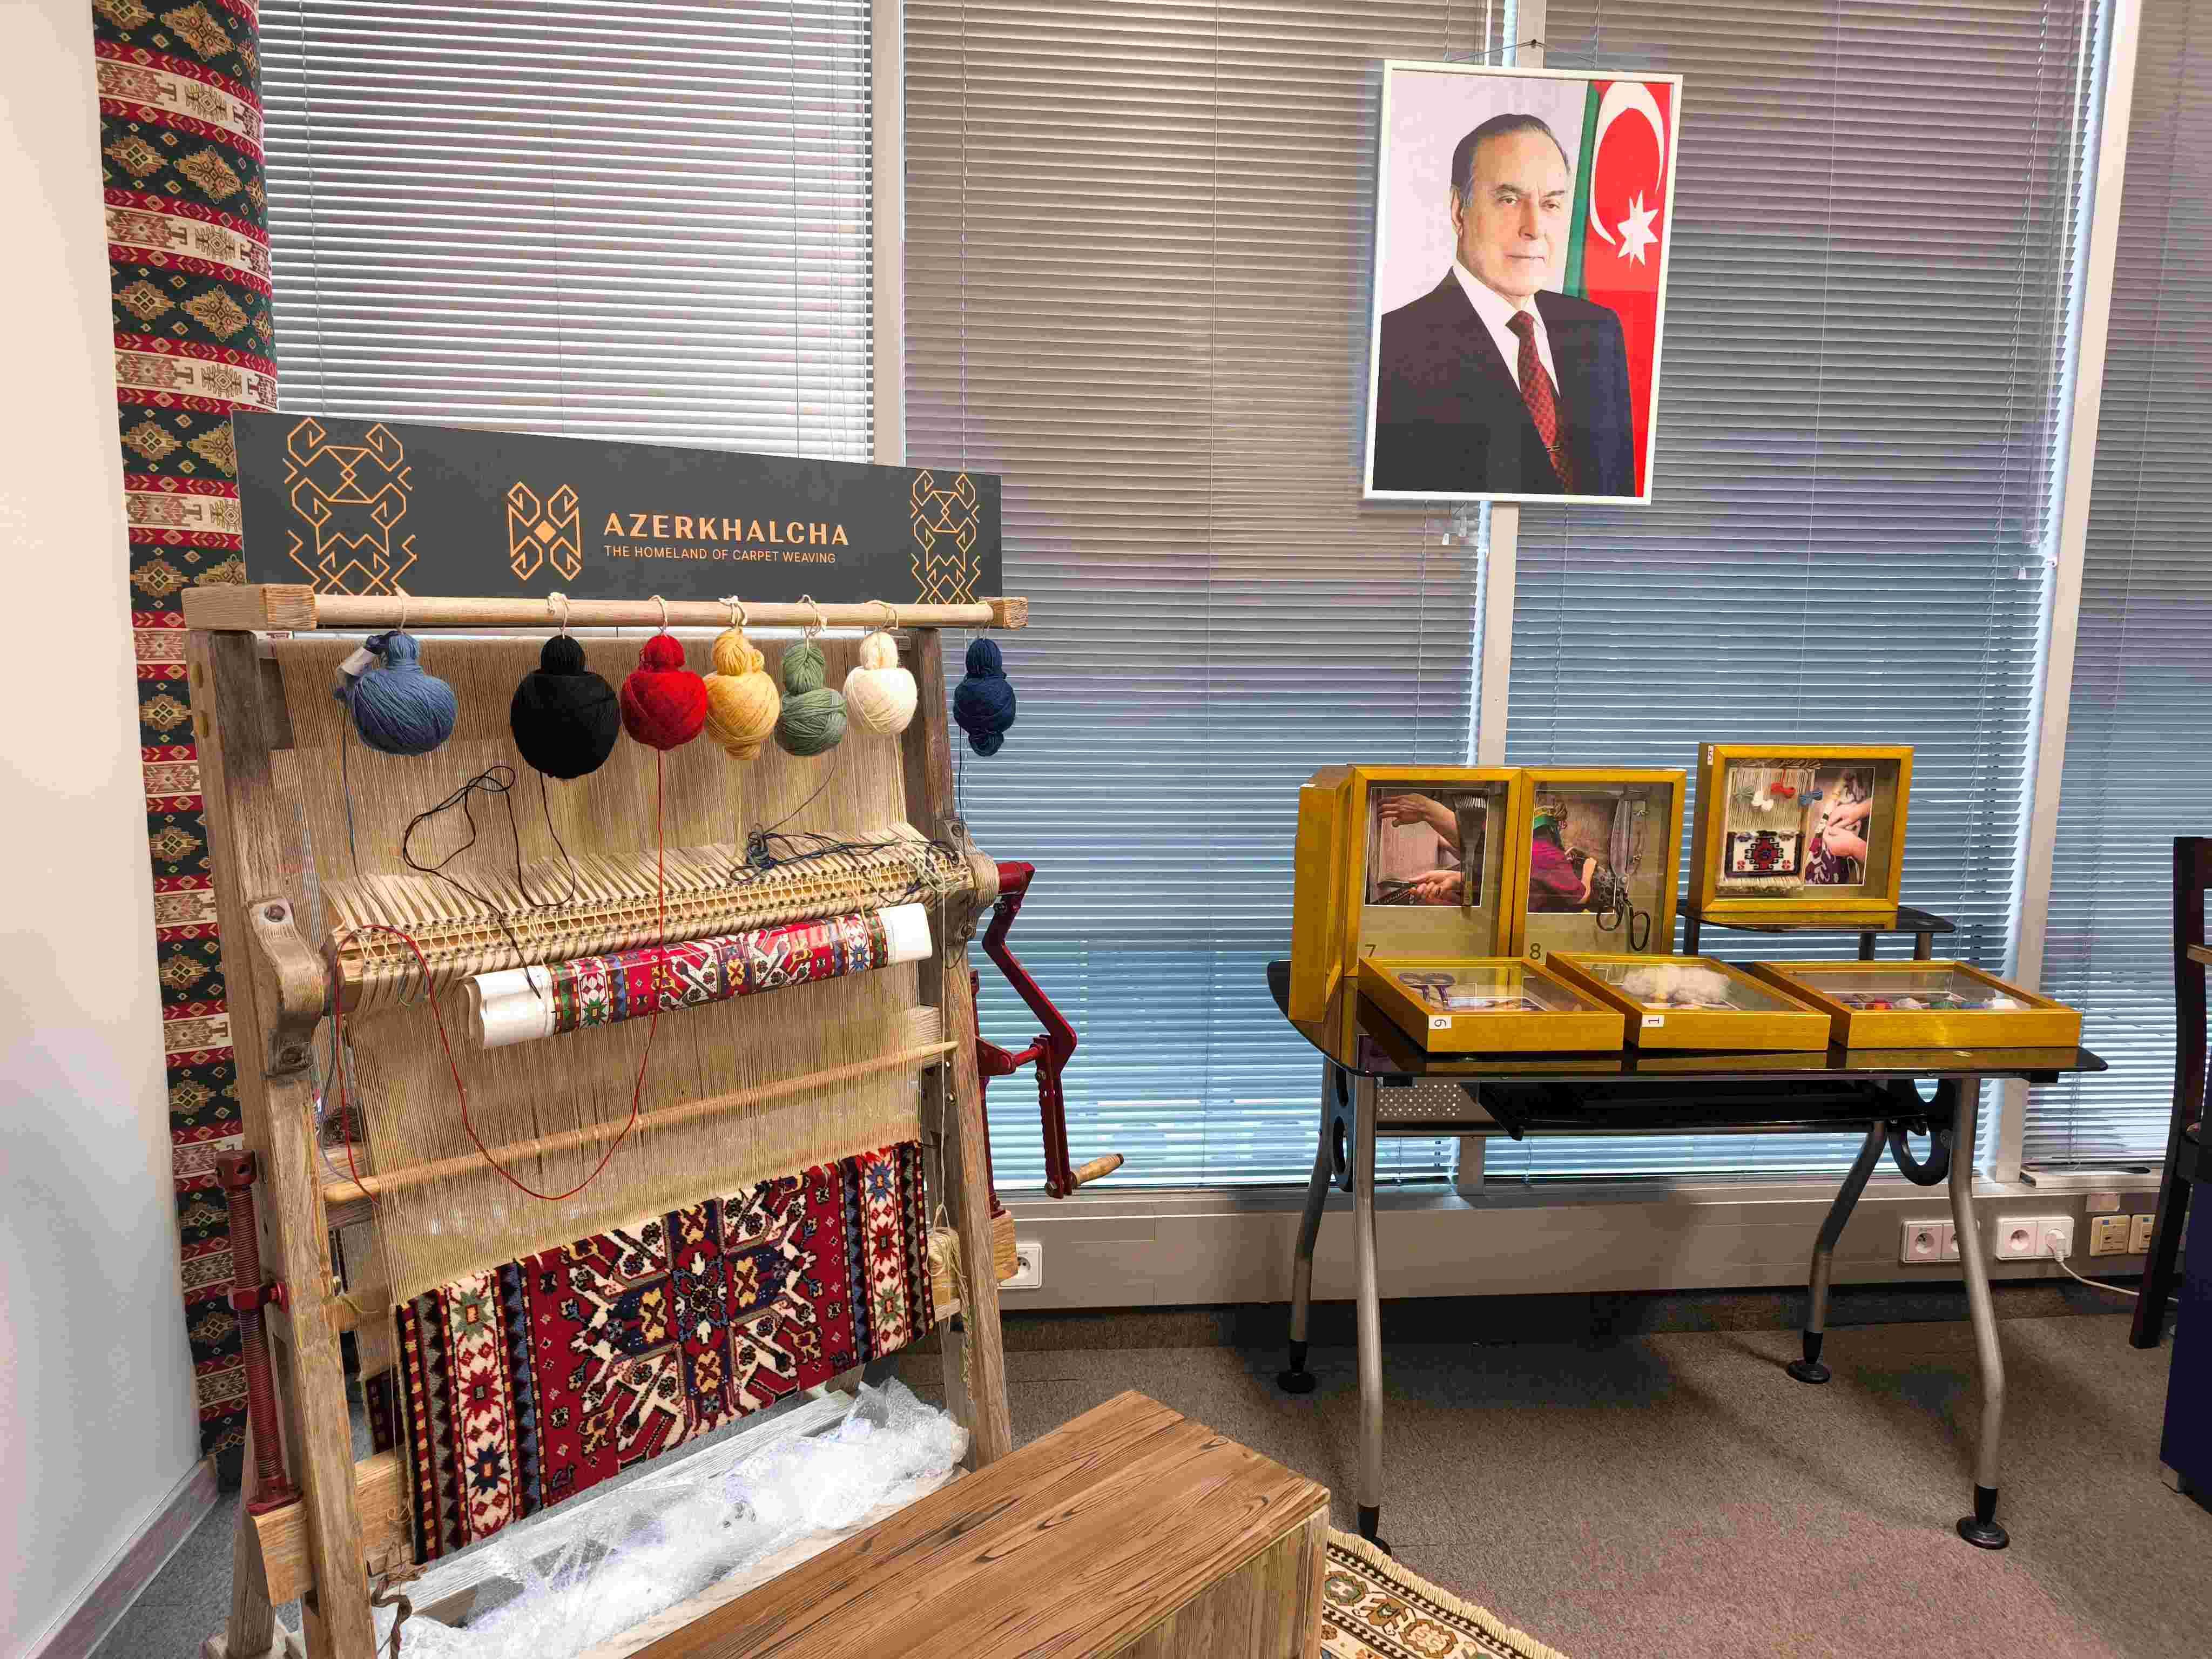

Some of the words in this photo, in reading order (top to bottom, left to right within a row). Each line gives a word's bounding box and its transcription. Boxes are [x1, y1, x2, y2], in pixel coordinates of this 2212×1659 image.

[603, 512, 849, 546] AZERKHALCHA
[603, 544, 631, 558] THE
[634, 545, 708, 559] HOMELAND
[712, 549, 729, 560] OF
[732, 549, 779, 562] CARPET
[782, 551, 836, 564] WEAVING
[1365, 943, 1377, 958] 7
[1529, 942, 1541, 960] 8
